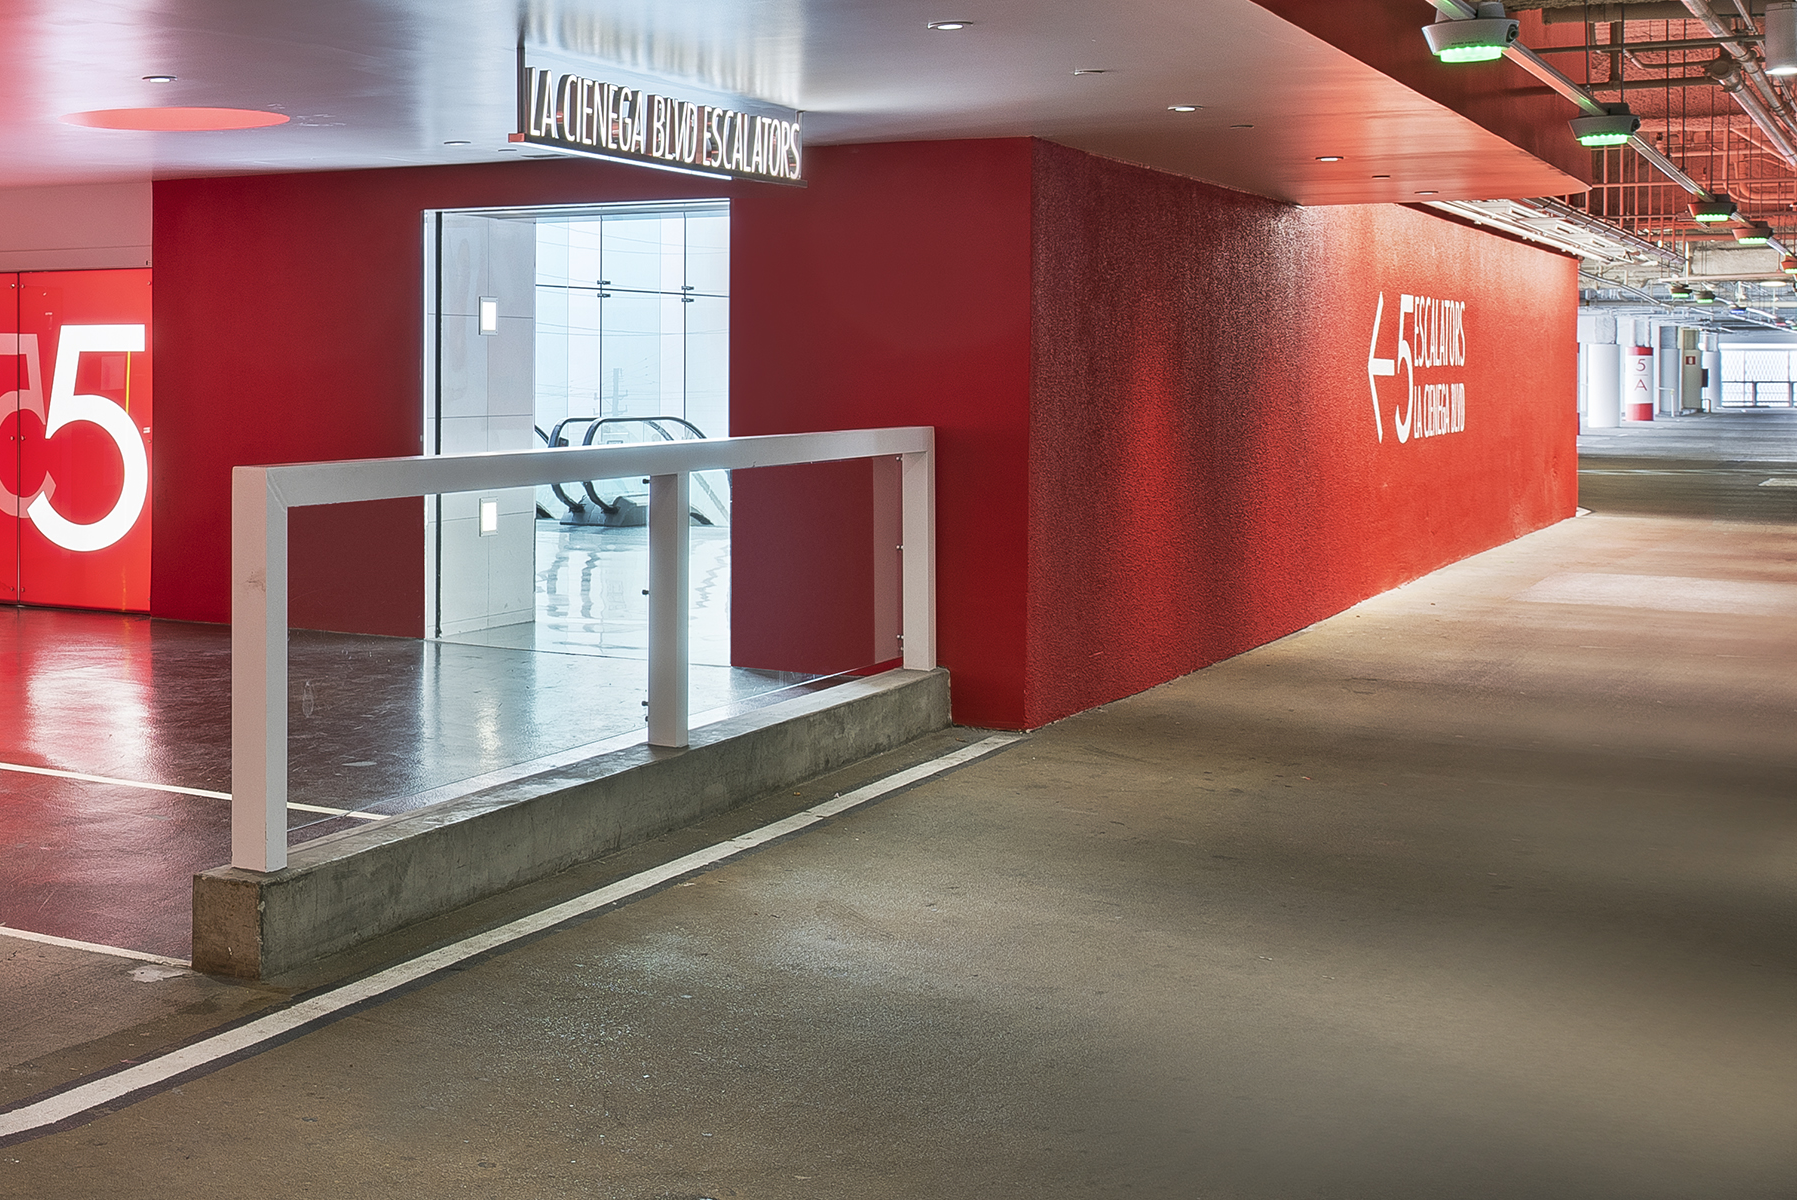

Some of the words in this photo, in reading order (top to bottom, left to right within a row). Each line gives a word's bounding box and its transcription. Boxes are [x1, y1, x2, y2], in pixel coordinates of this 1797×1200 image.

[527, 66, 558, 139] LA
[562, 73, 645, 156] CIENEGA
[652, 94, 698, 165] BLVD
[702, 105, 802, 180] ESCALATORS
[1414, 295, 1466, 368] ESCALATORS
[1635, 358, 1646, 372] 5
[1395, 294, 1413, 443] 5
[1634, 378, 1648, 391] A
[27, 324, 149, 552] 5
[1413, 385, 1423, 439] LA
